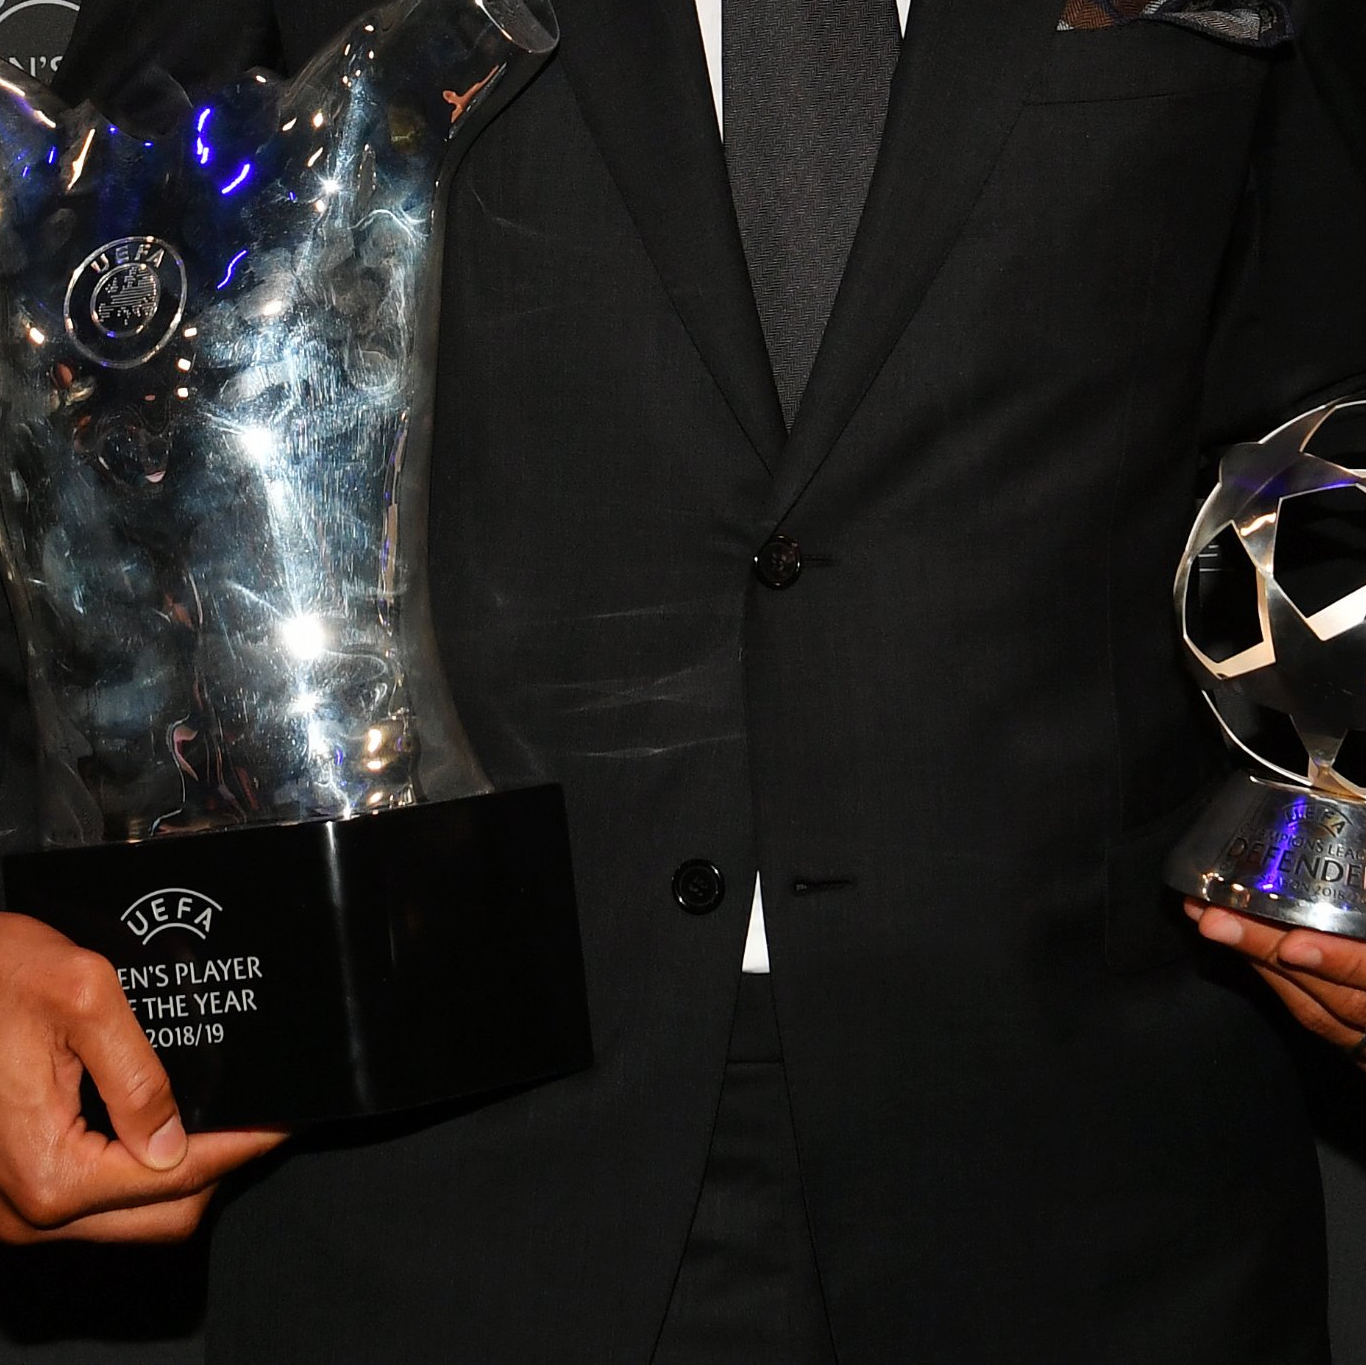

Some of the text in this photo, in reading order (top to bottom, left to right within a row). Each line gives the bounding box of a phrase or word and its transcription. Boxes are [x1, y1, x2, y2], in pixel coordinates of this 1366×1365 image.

[91, 243, 166, 274] UEFA
[126, 896, 213, 937] UEFA
[117, 956, 263, 990] EN'S PLAYER
[142, 995, 189, 1020] THE
[193, 989, 258, 1016] YEAR
[145, 1023, 225, 1049] 2018/19
